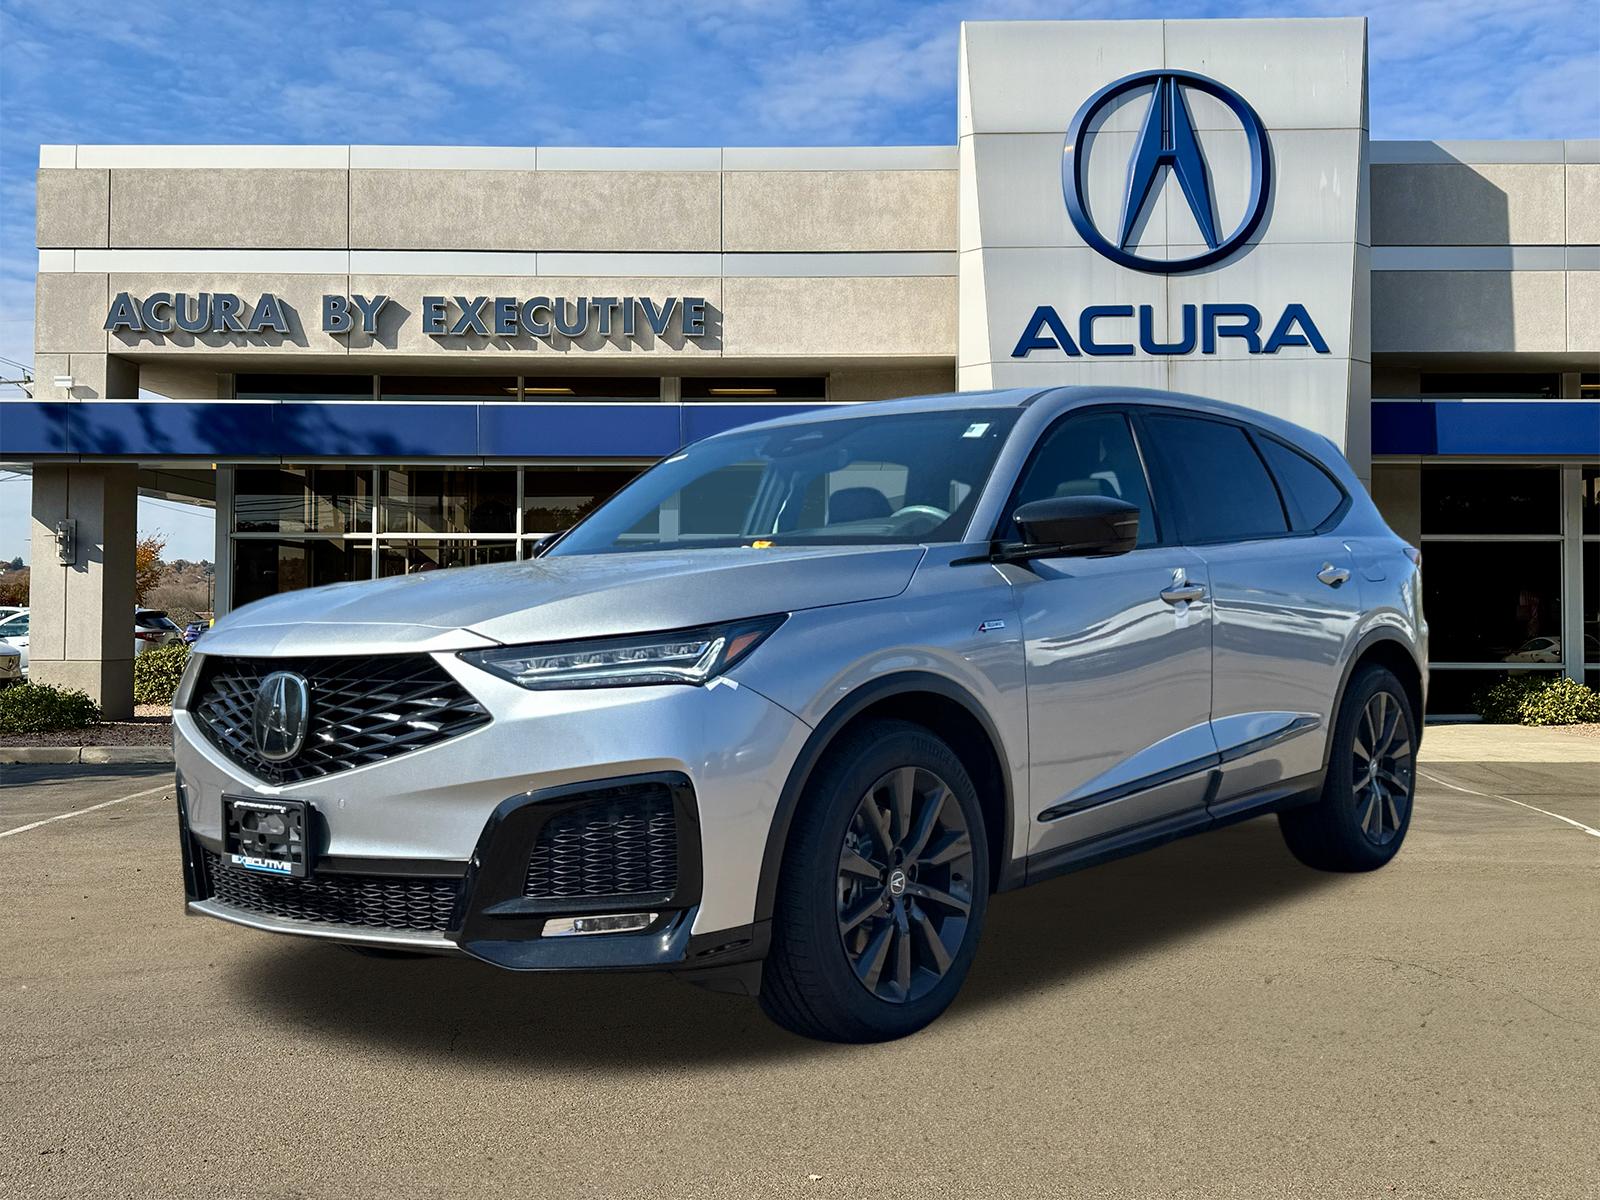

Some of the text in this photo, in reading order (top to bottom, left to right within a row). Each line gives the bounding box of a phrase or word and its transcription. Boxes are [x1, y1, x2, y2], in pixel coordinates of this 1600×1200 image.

[103, 291, 706, 338] ACURA BY EXECUTIVE
[1010, 303, 1333, 357] ACURA
[231, 854, 292, 872] EXECUTIVE
